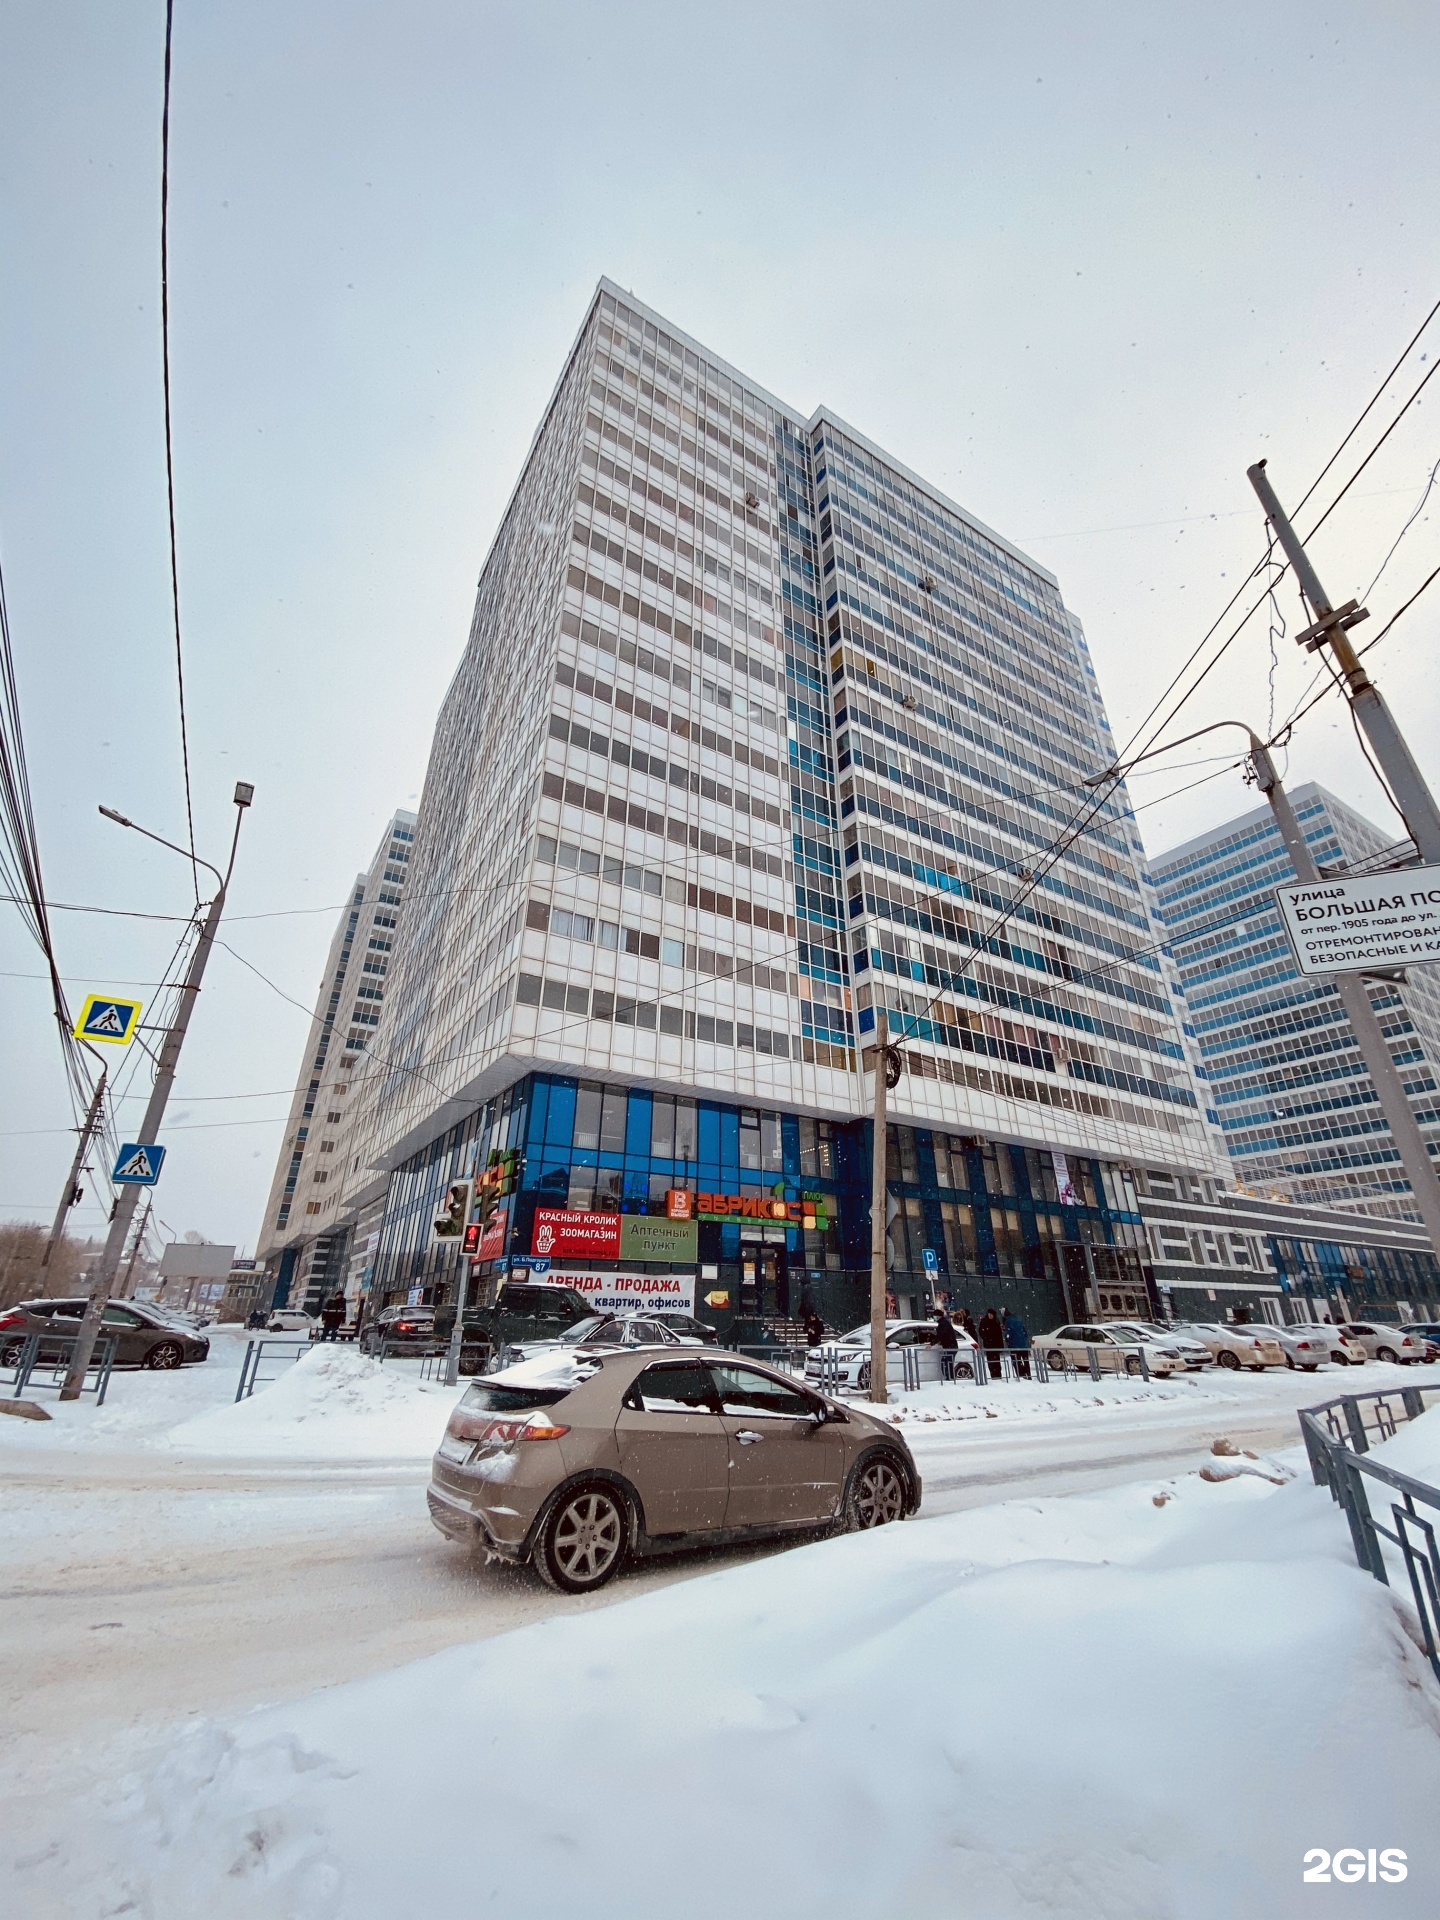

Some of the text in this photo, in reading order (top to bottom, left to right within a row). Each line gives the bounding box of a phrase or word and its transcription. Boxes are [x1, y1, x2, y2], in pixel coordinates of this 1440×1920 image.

[1289, 888, 1346, 905] улица
[1295, 896, 1406, 921] БОЛЬШАЯ
[1316, 925, 1341, 934] пер.
[1342, 918, 1369, 930] 1905
[1372, 917, 1398, 926] года
[1401, 914, 1416, 923] до
[1419, 911, 1437, 922] ул.
[1306, 926, 1440, 950] ОТРЕМОНТИРОВАН
[1310, 944, 1408, 964] БЕЗОПАСНЫЕ
[1410, 943, 1422, 952] И
[539, 1212, 617, 1226] КРАСНЫЙ КРОЛИК
[560, 1227, 617, 1240] ЗООМАГАЗИН
[630, 1224, 689, 1239] Аптечный
[643, 1240, 677, 1254] пункт
[535, 1262, 546, 1271] 87
[615, 1278, 681, 1293] ПРОДАЖА
[594, 1297, 645, 1310] квартир,
[647, 1297, 690, 1310] офисов
